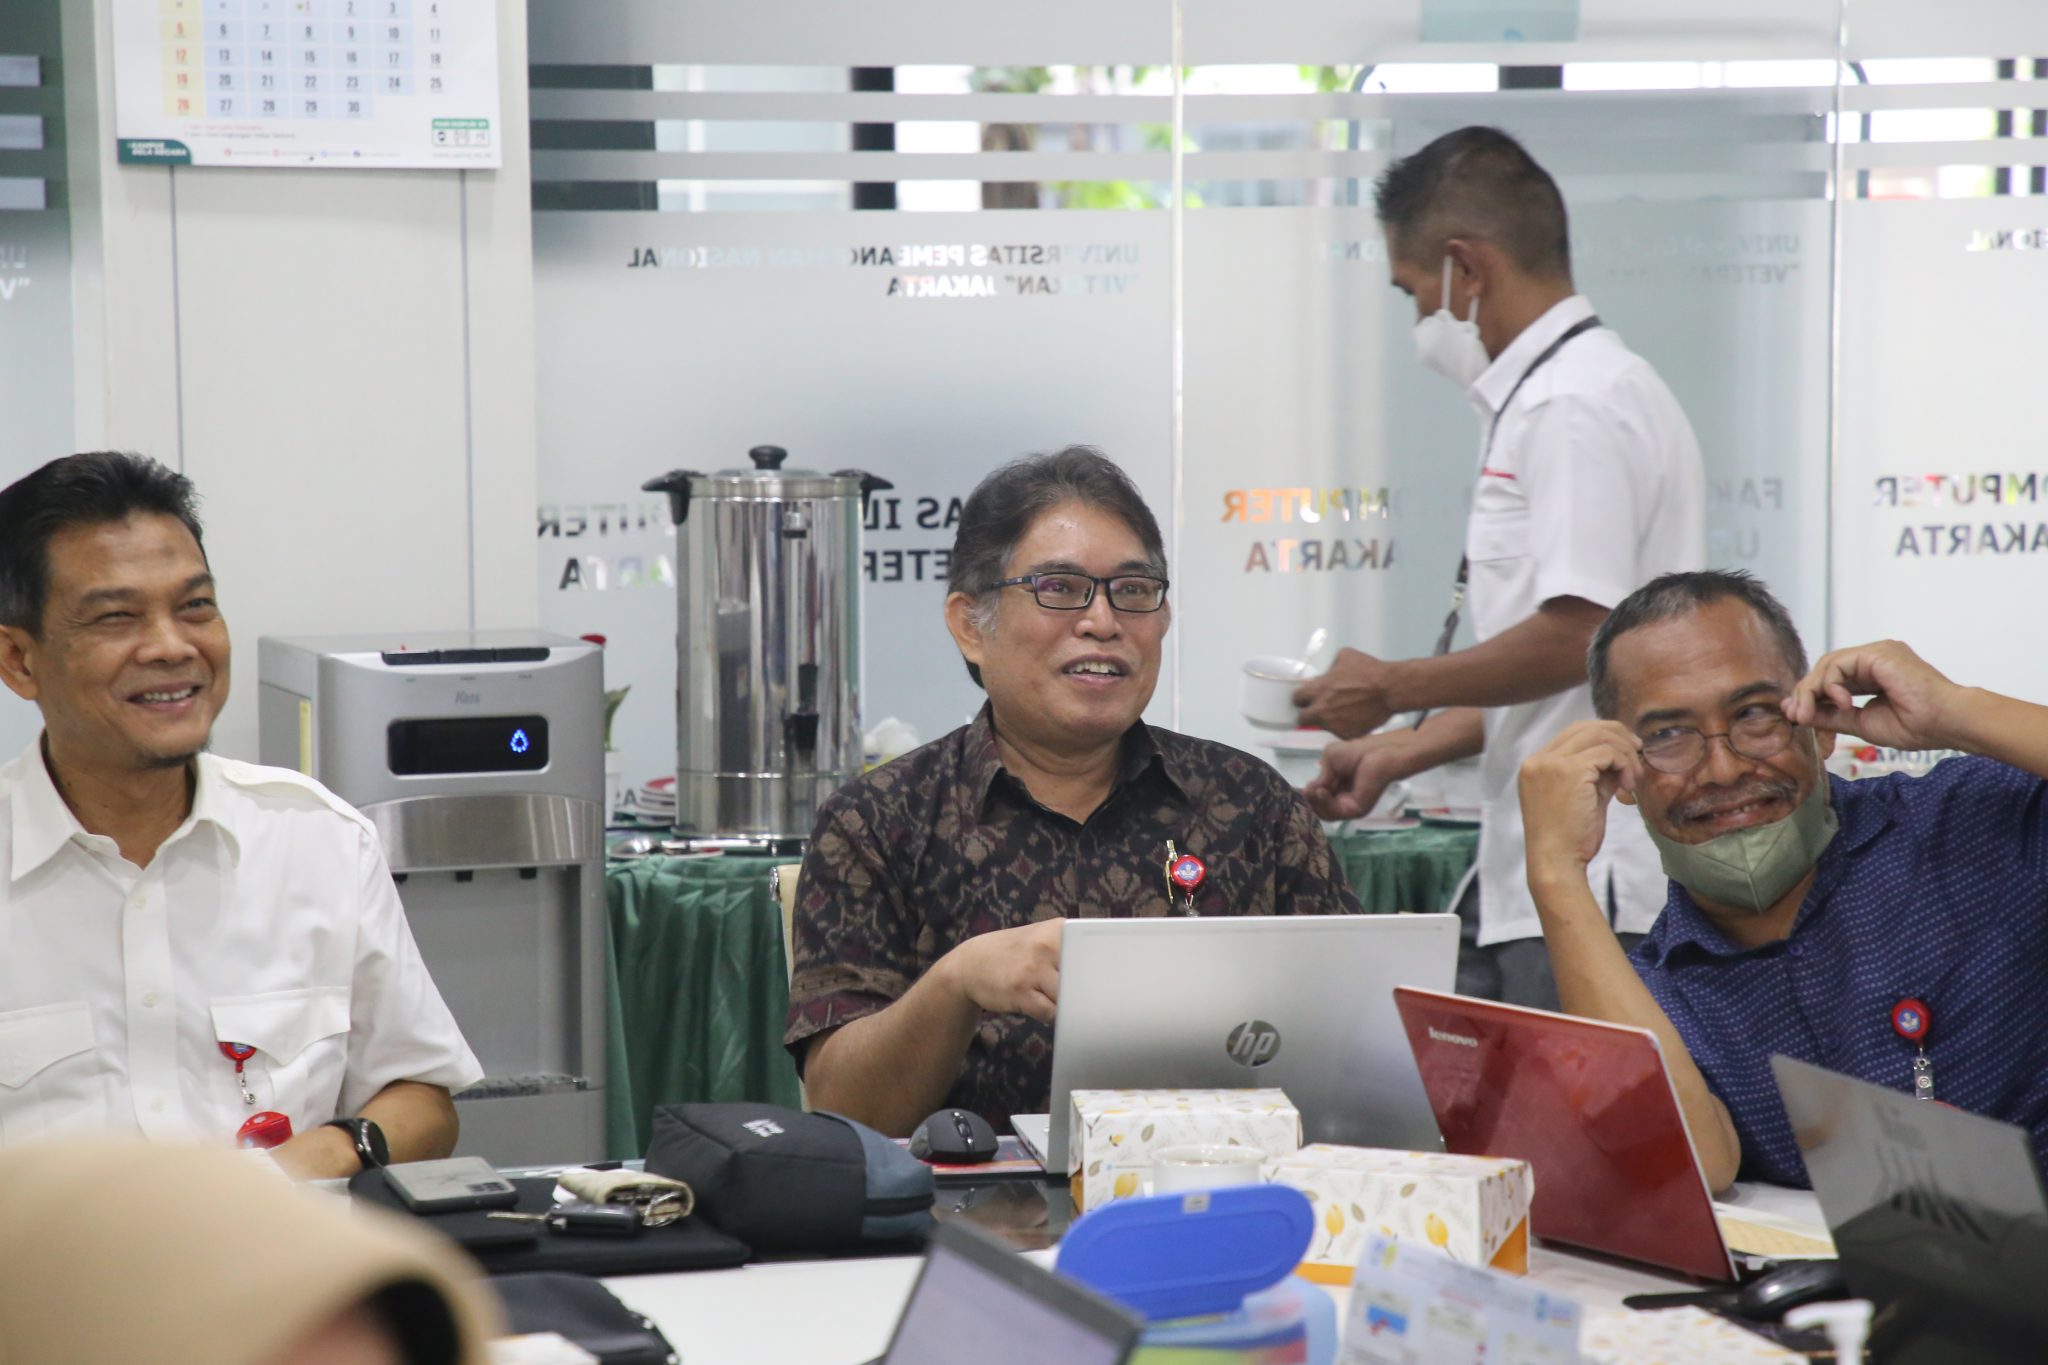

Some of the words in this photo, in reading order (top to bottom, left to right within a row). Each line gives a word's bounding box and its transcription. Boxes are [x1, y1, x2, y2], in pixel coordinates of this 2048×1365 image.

[388, 27, 399, 39] 10
[430, 28, 440, 39] 11
[176, 49, 187, 61] 12
[219, 49, 230, 61] 13
[262, 50, 272, 62] 14
[304, 51, 315, 63] 15
[346, 52, 357, 64] 16
[389, 53, 399, 64] 17
[430, 54, 441, 65] 18
[177, 73, 188, 86] 19
[219, 74, 231, 86] 20
[262, 75, 274, 87] 21
[304, 75, 317, 88] 22
[346, 76, 358, 88] 23
[389, 77, 400, 88] 24
[430, 78, 442, 90] 25
[177, 98, 189, 111] 26
[220, 99, 232, 112] 27
[263, 100, 275, 112] 28
[305, 100, 317, 113] 29
[347, 101, 359, 113] 30
[1231, 1022, 1277, 1067] hp
[1428, 1026, 1479, 1048] lenovo
